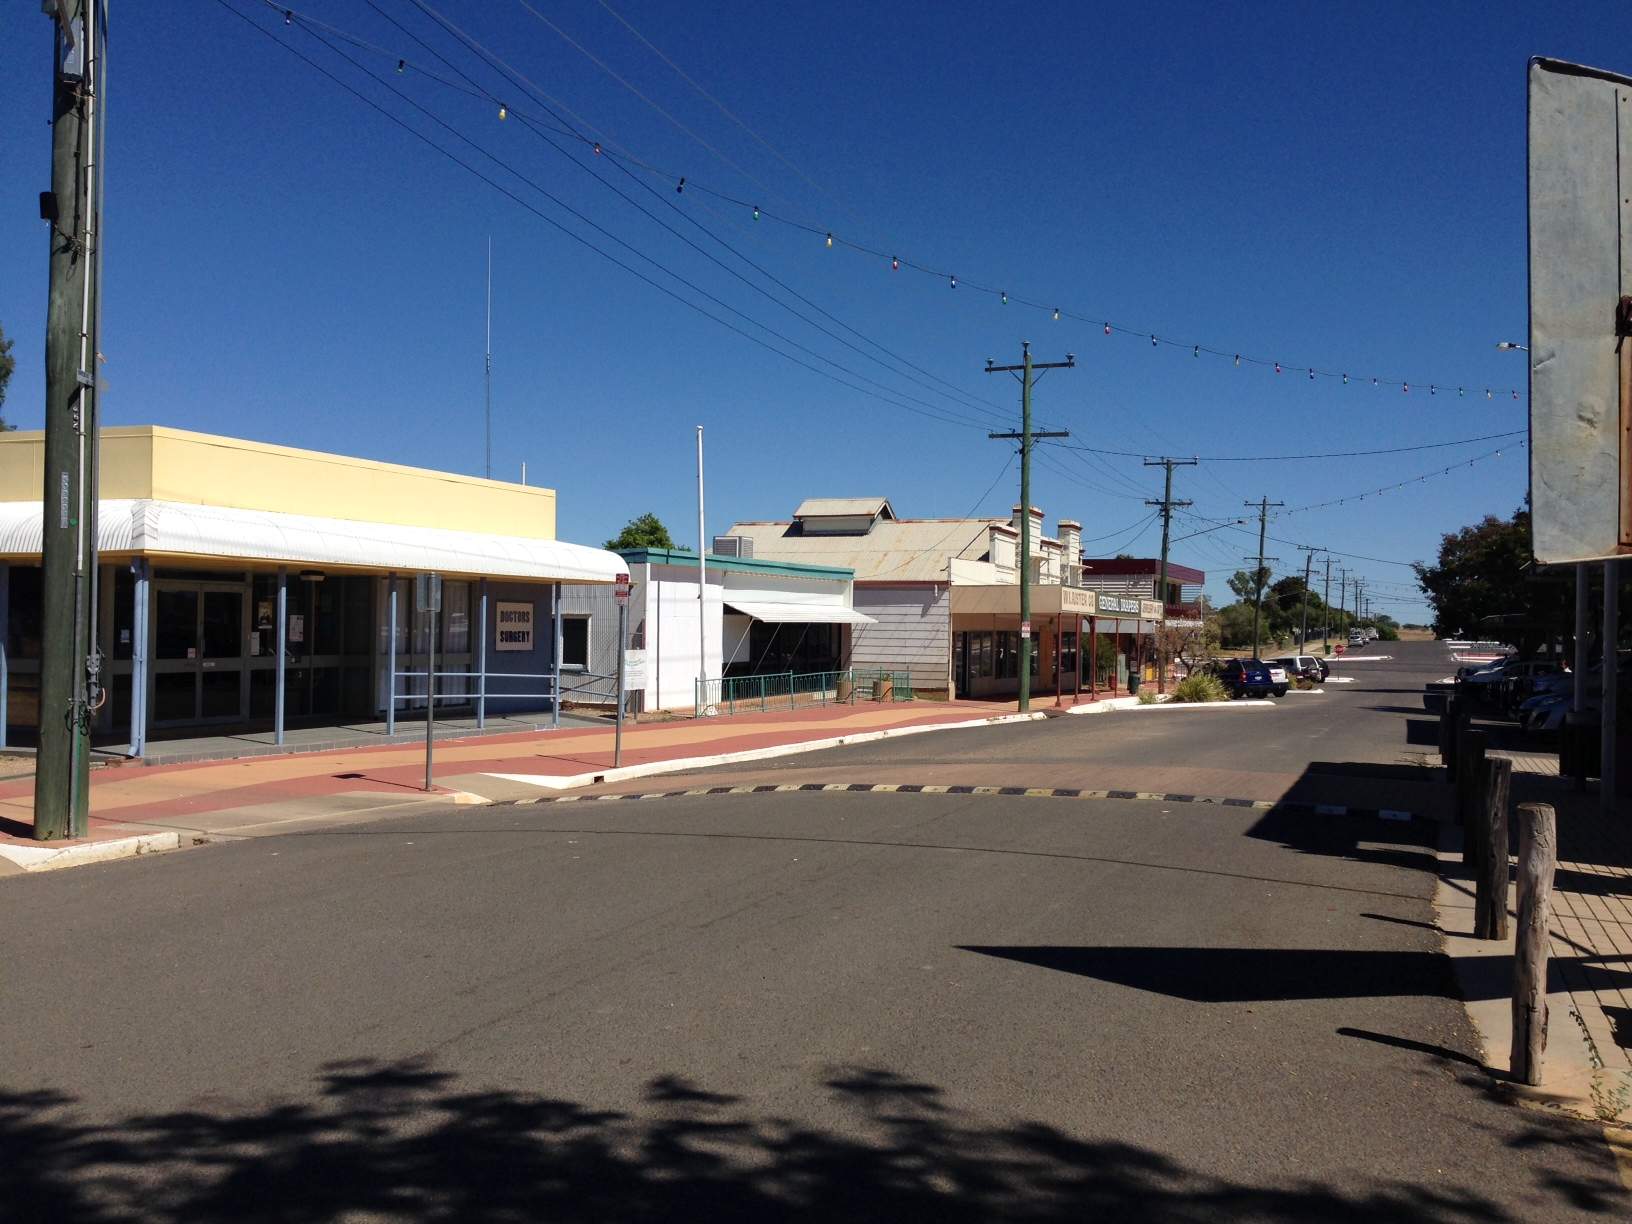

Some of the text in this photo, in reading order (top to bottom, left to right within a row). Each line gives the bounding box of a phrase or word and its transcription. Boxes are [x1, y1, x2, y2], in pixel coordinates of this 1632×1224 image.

[1099, 595, 1119, 611] GENERAL
[500, 610, 530, 623] DOCTORS
[500, 630, 530, 643] SURGERY
